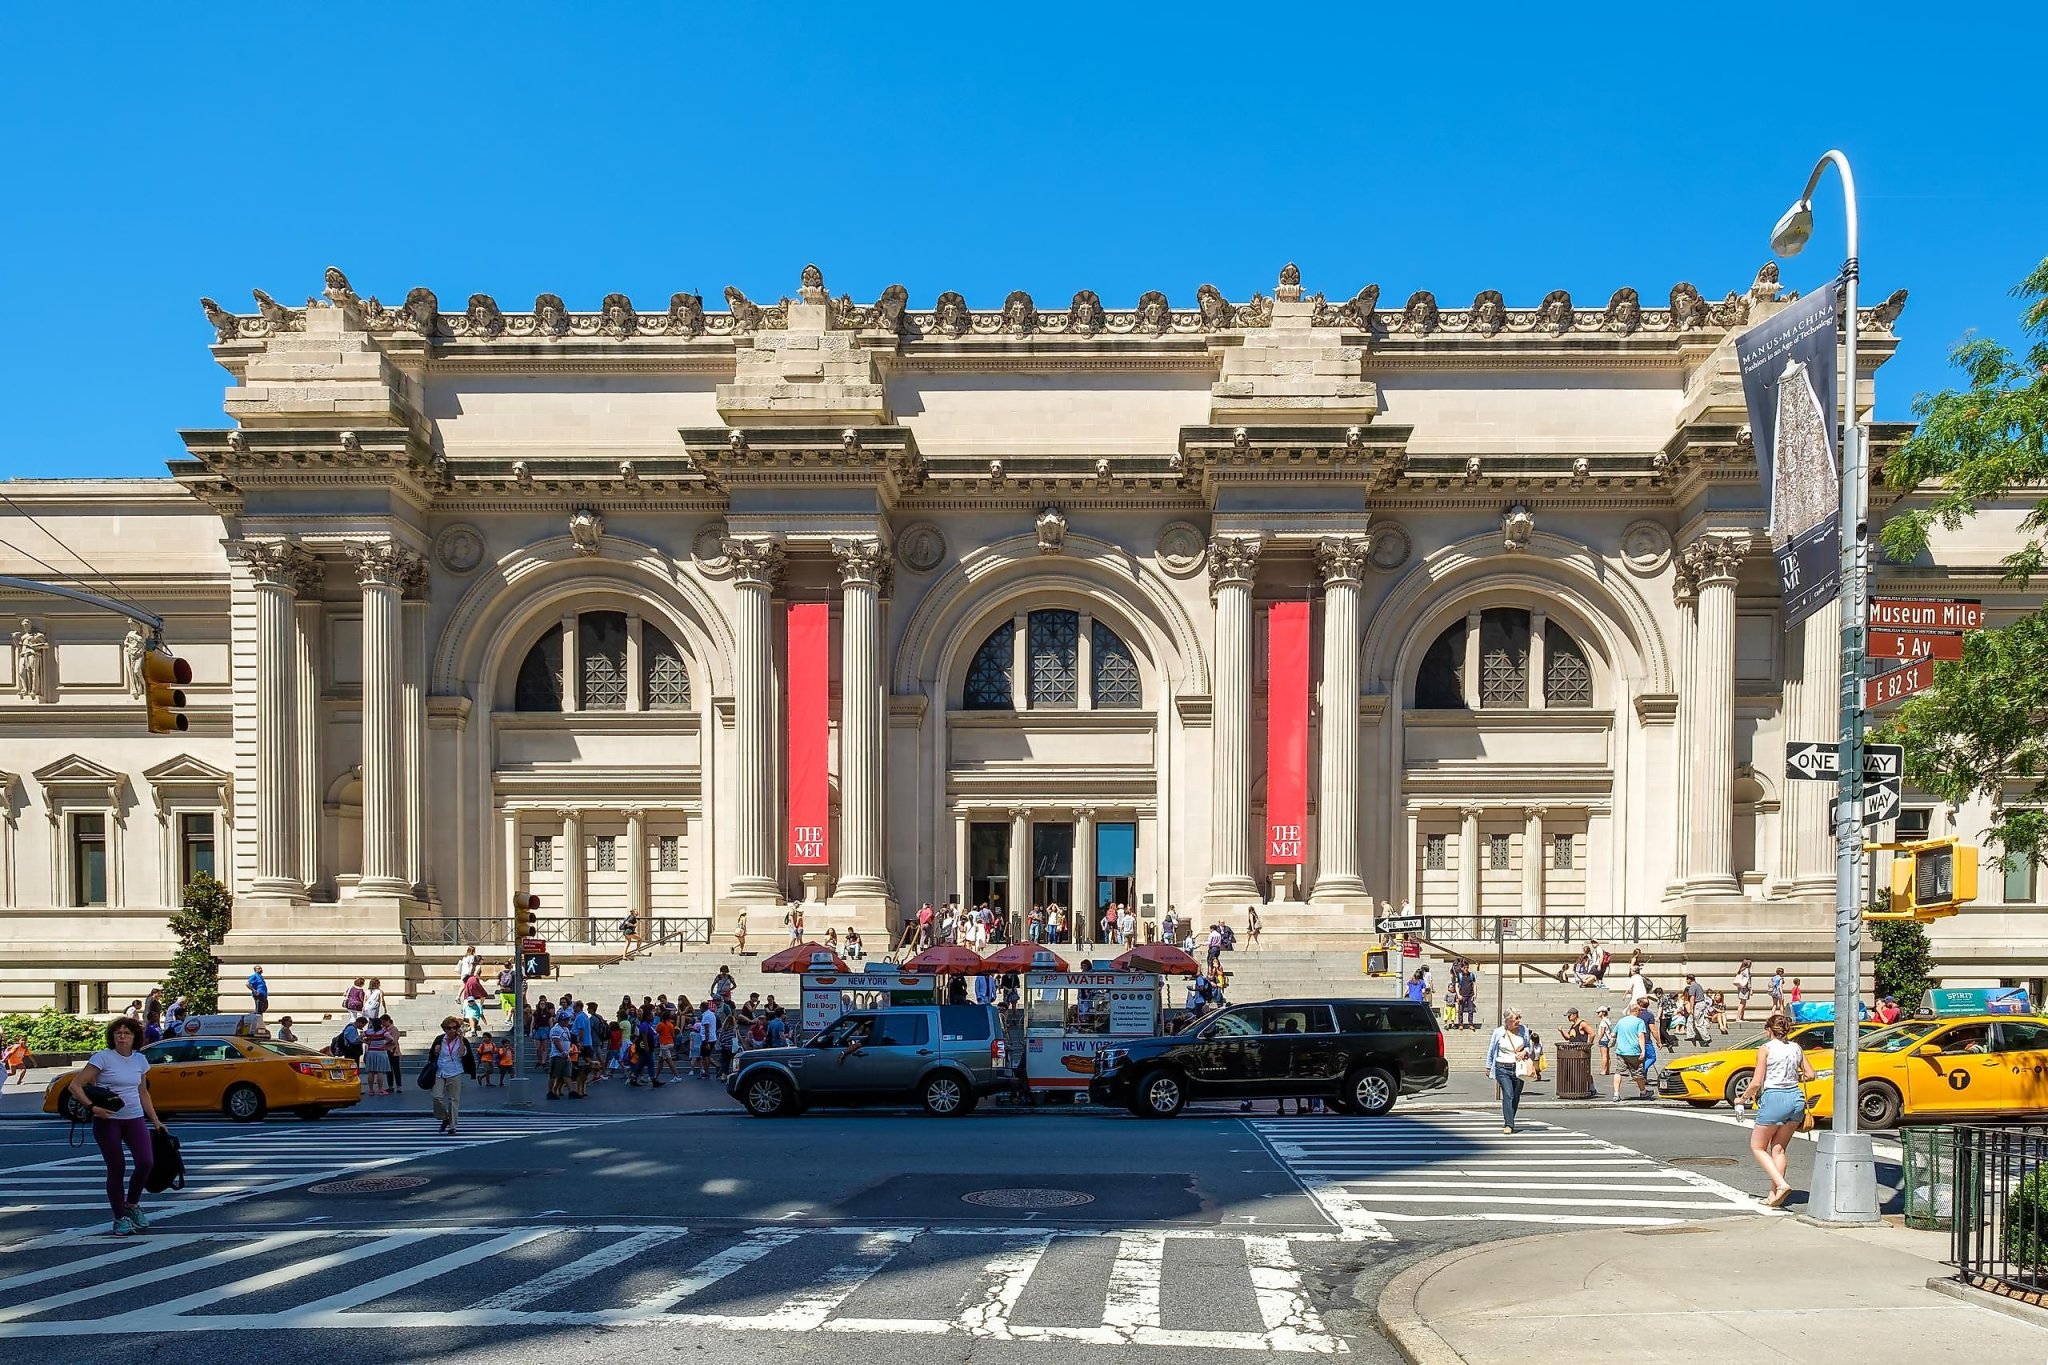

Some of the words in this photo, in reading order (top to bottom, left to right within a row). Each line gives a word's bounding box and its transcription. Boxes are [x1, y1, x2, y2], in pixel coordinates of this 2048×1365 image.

[1742, 336, 1779, 365] MANUS
[1782, 304, 1834, 341] MACHINA
[1744, 357, 1767, 374] Fashion
[1767, 353, 1774, 361] in
[1773, 348, 1782, 357] an
[1781, 341, 1794, 351] Age
[1793, 335, 1800, 344] of
[1800, 315, 1834, 340] Technology
[1780, 551, 1799, 576] TE
[1782, 567, 1801, 594] MT
[1869, 603, 1936, 624] Museum
[1943, 605, 1977, 626] Mile
[1896, 636, 1905, 656] 5
[1911, 637, 1931, 657] Av
[1877, 681, 1883, 701] E
[1889, 674, 1902, 697] 82
[1906, 667, 1919, 691] St
[1798, 754, 1835, 770] ONE
[1868, 792, 1892, 813] WAY
[794, 826, 823, 842] THE
[1271, 825, 1301, 841] THE
[794, 842, 824, 858] MET
[1271, 841, 1302, 857] MET
[1382, 921, 1397, 929] ONE
[847, 977, 866, 985] NEW
[867, 977, 888, 985] YORK
[1067, 975, 1115, 985] WATER
[1946, 992, 1974, 1000] SPIRIT
[1062, 1041, 1086, 1052] NEW
[1952, 1072, 1966, 1088] T
